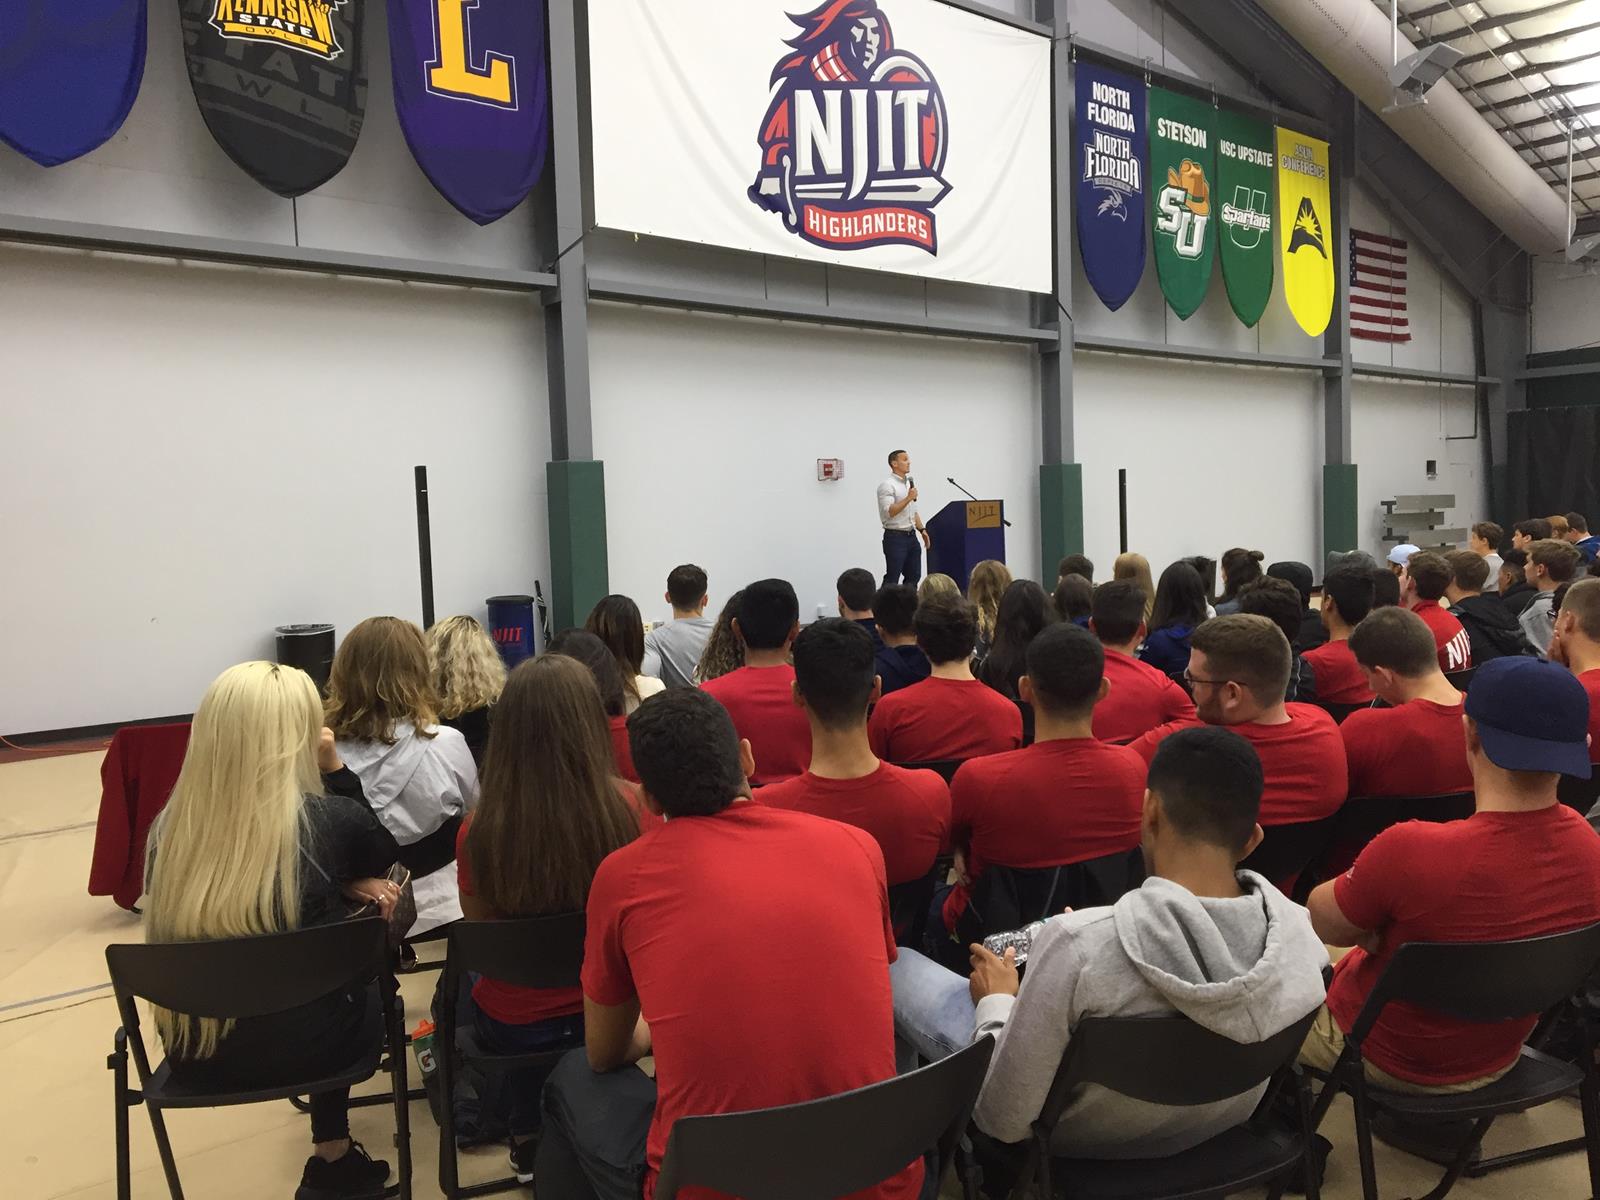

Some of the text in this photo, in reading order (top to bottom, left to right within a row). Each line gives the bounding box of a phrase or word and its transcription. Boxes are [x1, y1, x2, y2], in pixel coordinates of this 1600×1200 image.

[239, 13, 313, 38] STATE
[245, 26, 309, 45] OWLS
[1092, 81, 1131, 110] NORTH
[1087, 101, 1136, 133] FLORIDA
[794, 89, 930, 200] NJIT
[1096, 132, 1130, 160] NORTH
[1157, 117, 1207, 149] STETSON
[1086, 146, 1140, 189] FLORIDA
[1220, 139, 1273, 168] USC UPSTATE
[1281, 155, 1326, 180] CONFERENCE
[808, 208, 928, 239] HIGHLANDERS
[1157, 186, 1208, 257] SU
[968, 504, 996, 520] NJIT
[492, 627, 524, 642] NJIT
[417, 1048, 437, 1073] G
